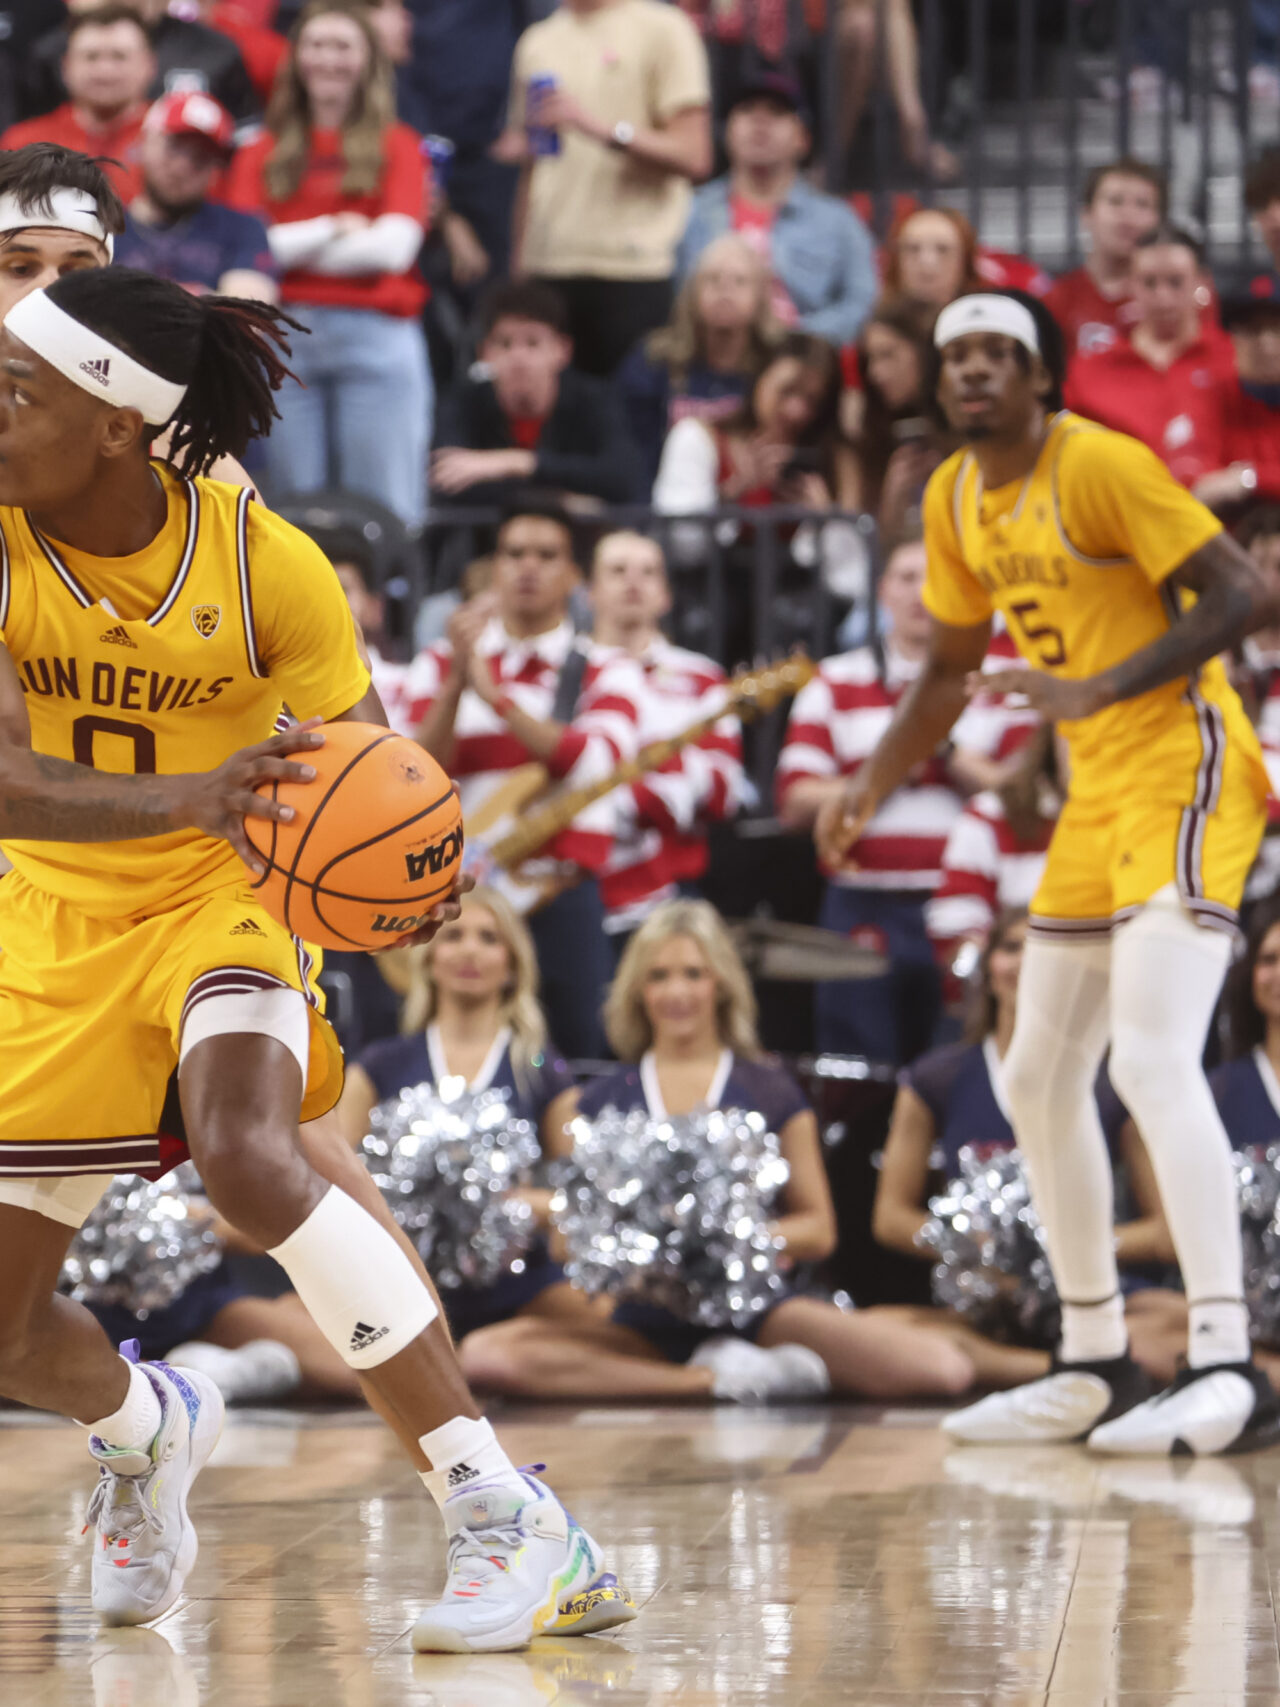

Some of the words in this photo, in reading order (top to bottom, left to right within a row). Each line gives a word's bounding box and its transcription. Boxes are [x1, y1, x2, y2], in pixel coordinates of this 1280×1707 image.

[79, 362, 110, 387] adidas
[200, 619, 214, 633] 12
[1010, 600, 1067, 667] 5
[99, 634, 139, 650] adidas
[92, 661, 234, 713] DEVILS
[405, 820, 465, 882] NCAA
[229, 929, 269, 939] adidas
[350, 1326, 390, 1352] adidas
